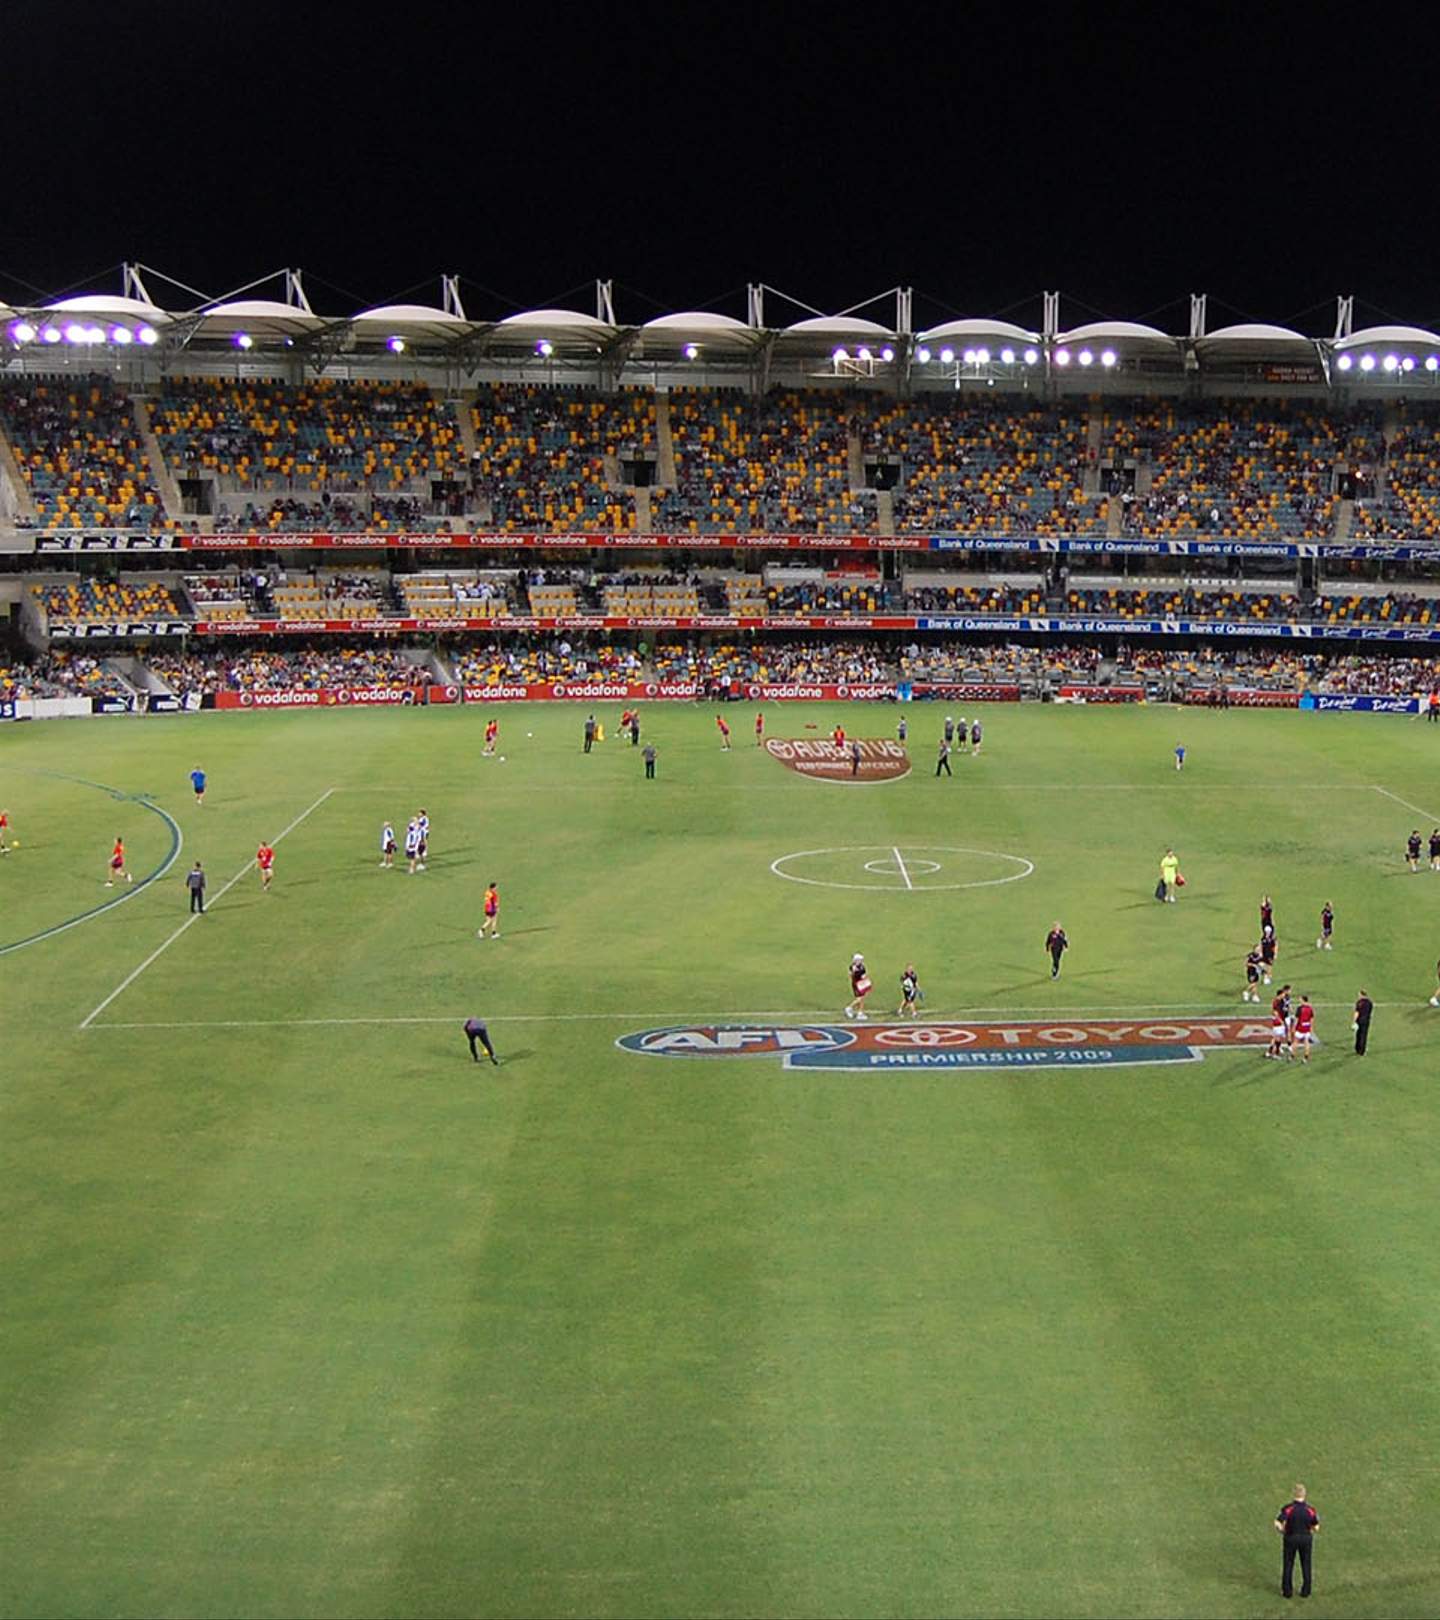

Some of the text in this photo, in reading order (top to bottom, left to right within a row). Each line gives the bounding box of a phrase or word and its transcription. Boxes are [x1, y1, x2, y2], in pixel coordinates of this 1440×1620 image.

[202, 537, 248, 546] vodafone
[269, 537, 313, 545] vodafone
[342, 537, 386, 545] vodafone
[408, 536, 451, 545] vodafone
[480, 537, 523, 545] vodafone
[544, 537, 586, 545] vodafone
[615, 537, 657, 545] vodafone
[677, 537, 720, 545] vodafone
[747, 536, 788, 546] vodafone
[809, 537, 851, 546] vodafone
[878, 538, 919, 547] vodafone
[938, 540, 962, 548] Bank
[976, 541, 1029, 549] Queensland
[1069, 541, 1160, 551] Bank of Queensland
[1198, 544, 1288, 554] Bank of Queensland
[927, 619, 950, 628] Bank
[964, 620, 1019, 630] Queensland
[1059, 621, 1151, 631] Bank of Queensland
[1189, 623, 1281, 634] Bank of Queensland
[464, 685, 527, 698] vodafone
[567, 682, 628, 696] vodafone
[762, 685, 823, 698] vodafone
[850, 686, 898, 698] vodafo
[254, 690, 318, 704] vodafone
[988, 1024, 1273, 1043] TOYOTA
[642, 1029, 838, 1049] AFL
[869, 1050, 1112, 1067] PREMIERSHIP 2009
